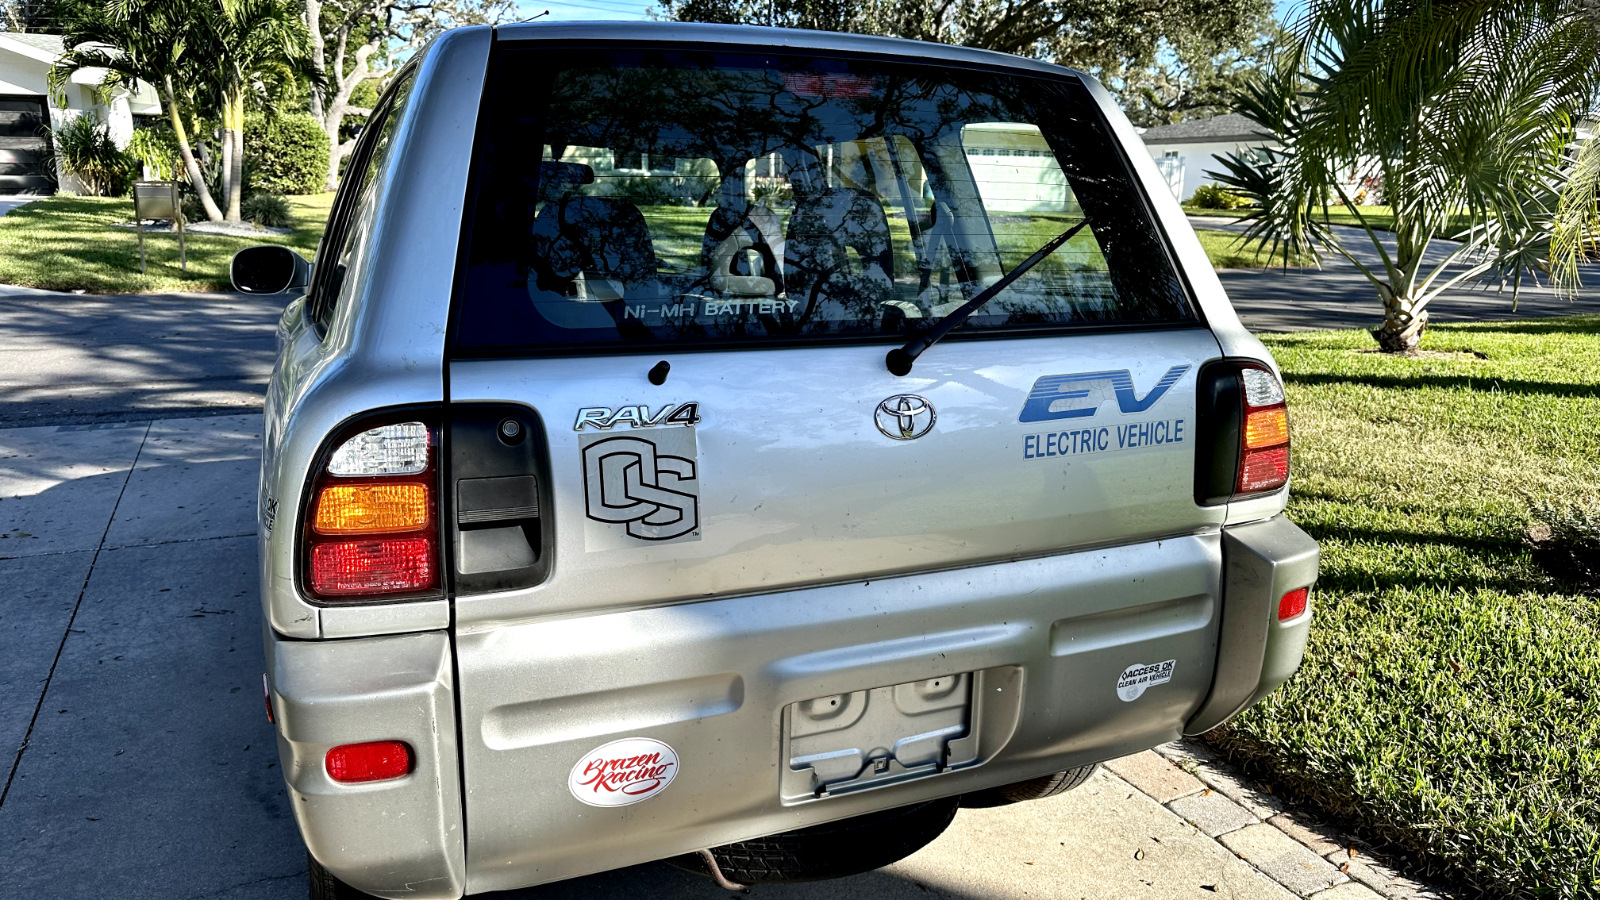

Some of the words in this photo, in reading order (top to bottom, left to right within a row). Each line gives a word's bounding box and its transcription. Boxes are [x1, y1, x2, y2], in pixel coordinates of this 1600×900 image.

[623, 303, 695, 319] Ni-MH
[704, 301, 799, 316] BATTERY
[1018, 364, 1191, 423] EV
[573, 401, 701, 431] RAV4
[1024, 427, 1109, 459] ELECTRIC
[1117, 419, 1184, 449] VEHICLE
[1118, 679, 1137, 689] CLEAN
[1137, 676, 1148, 684] AIR
[1149, 671, 1172, 682] VEHICLE
[1127, 664, 1161, 678] ACCESS
[1162, 660, 1174, 671] OK
[575, 751, 665, 785] Brazen
